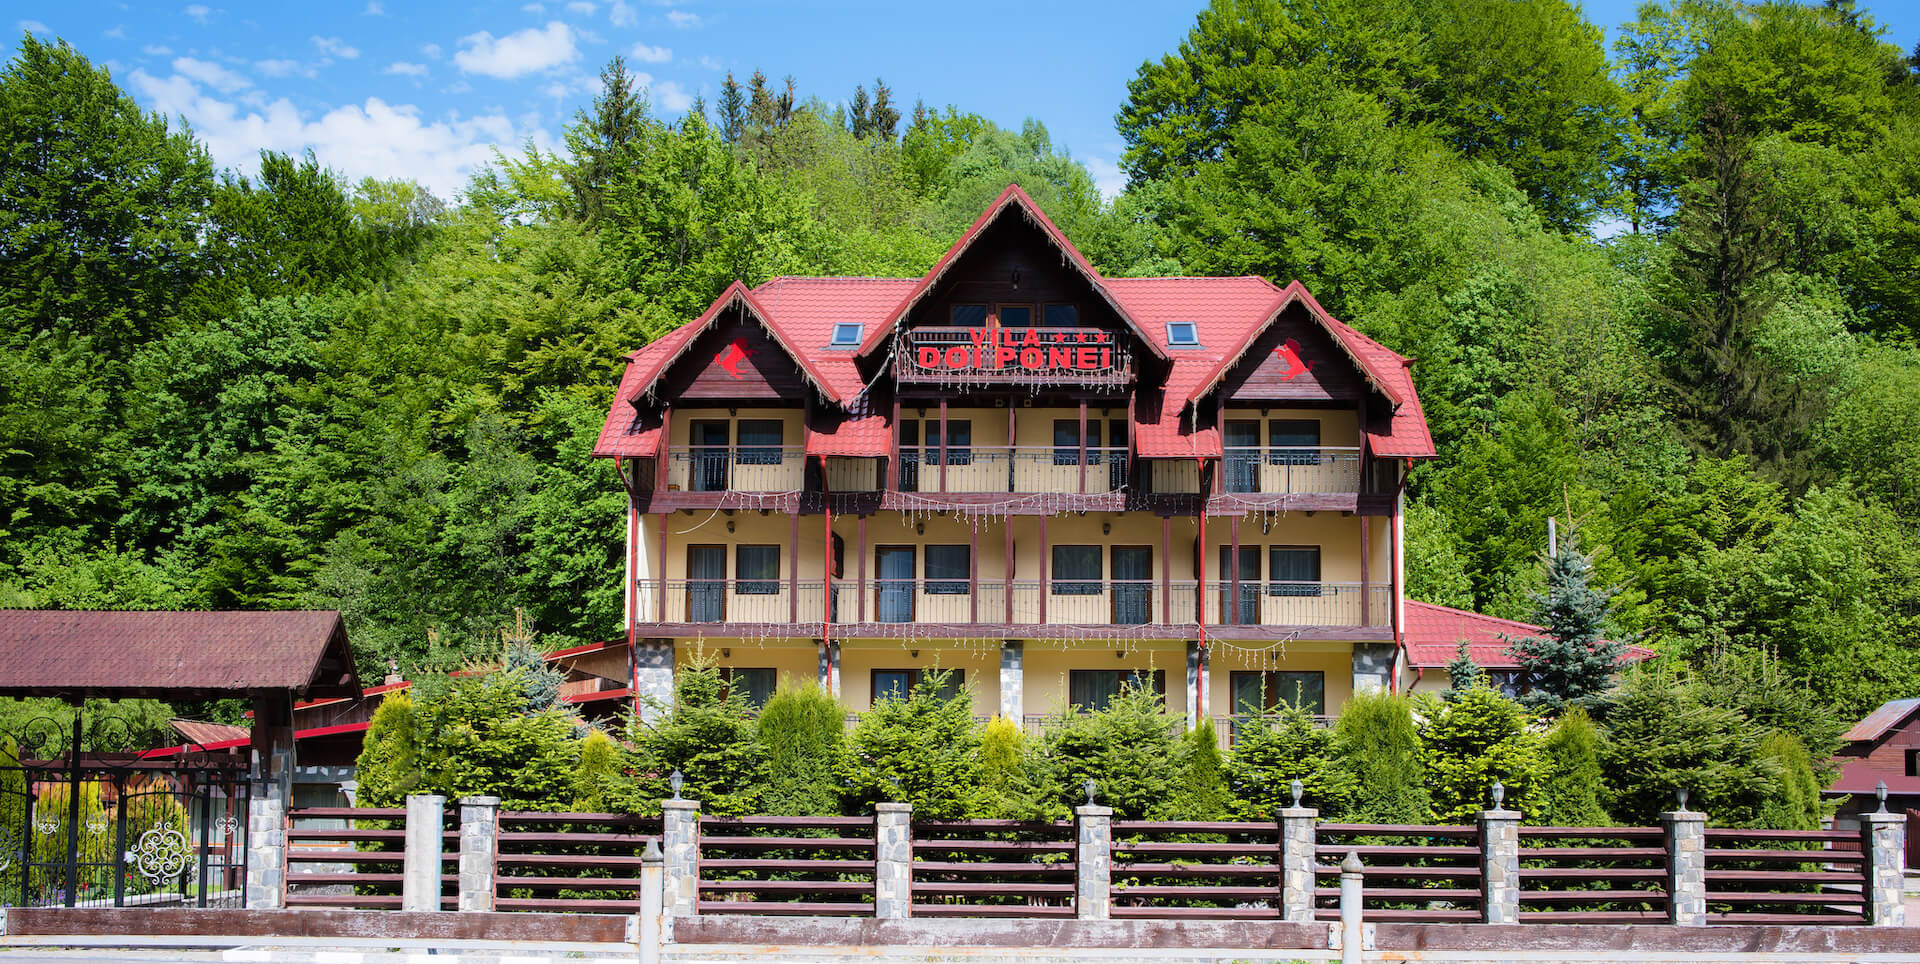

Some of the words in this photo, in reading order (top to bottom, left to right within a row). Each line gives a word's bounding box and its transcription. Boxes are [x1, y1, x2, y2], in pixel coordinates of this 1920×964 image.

[968, 328, 1041, 347] VILA
[918, 347, 982, 369] DOI
[997, 347, 1111, 369] PONEI
